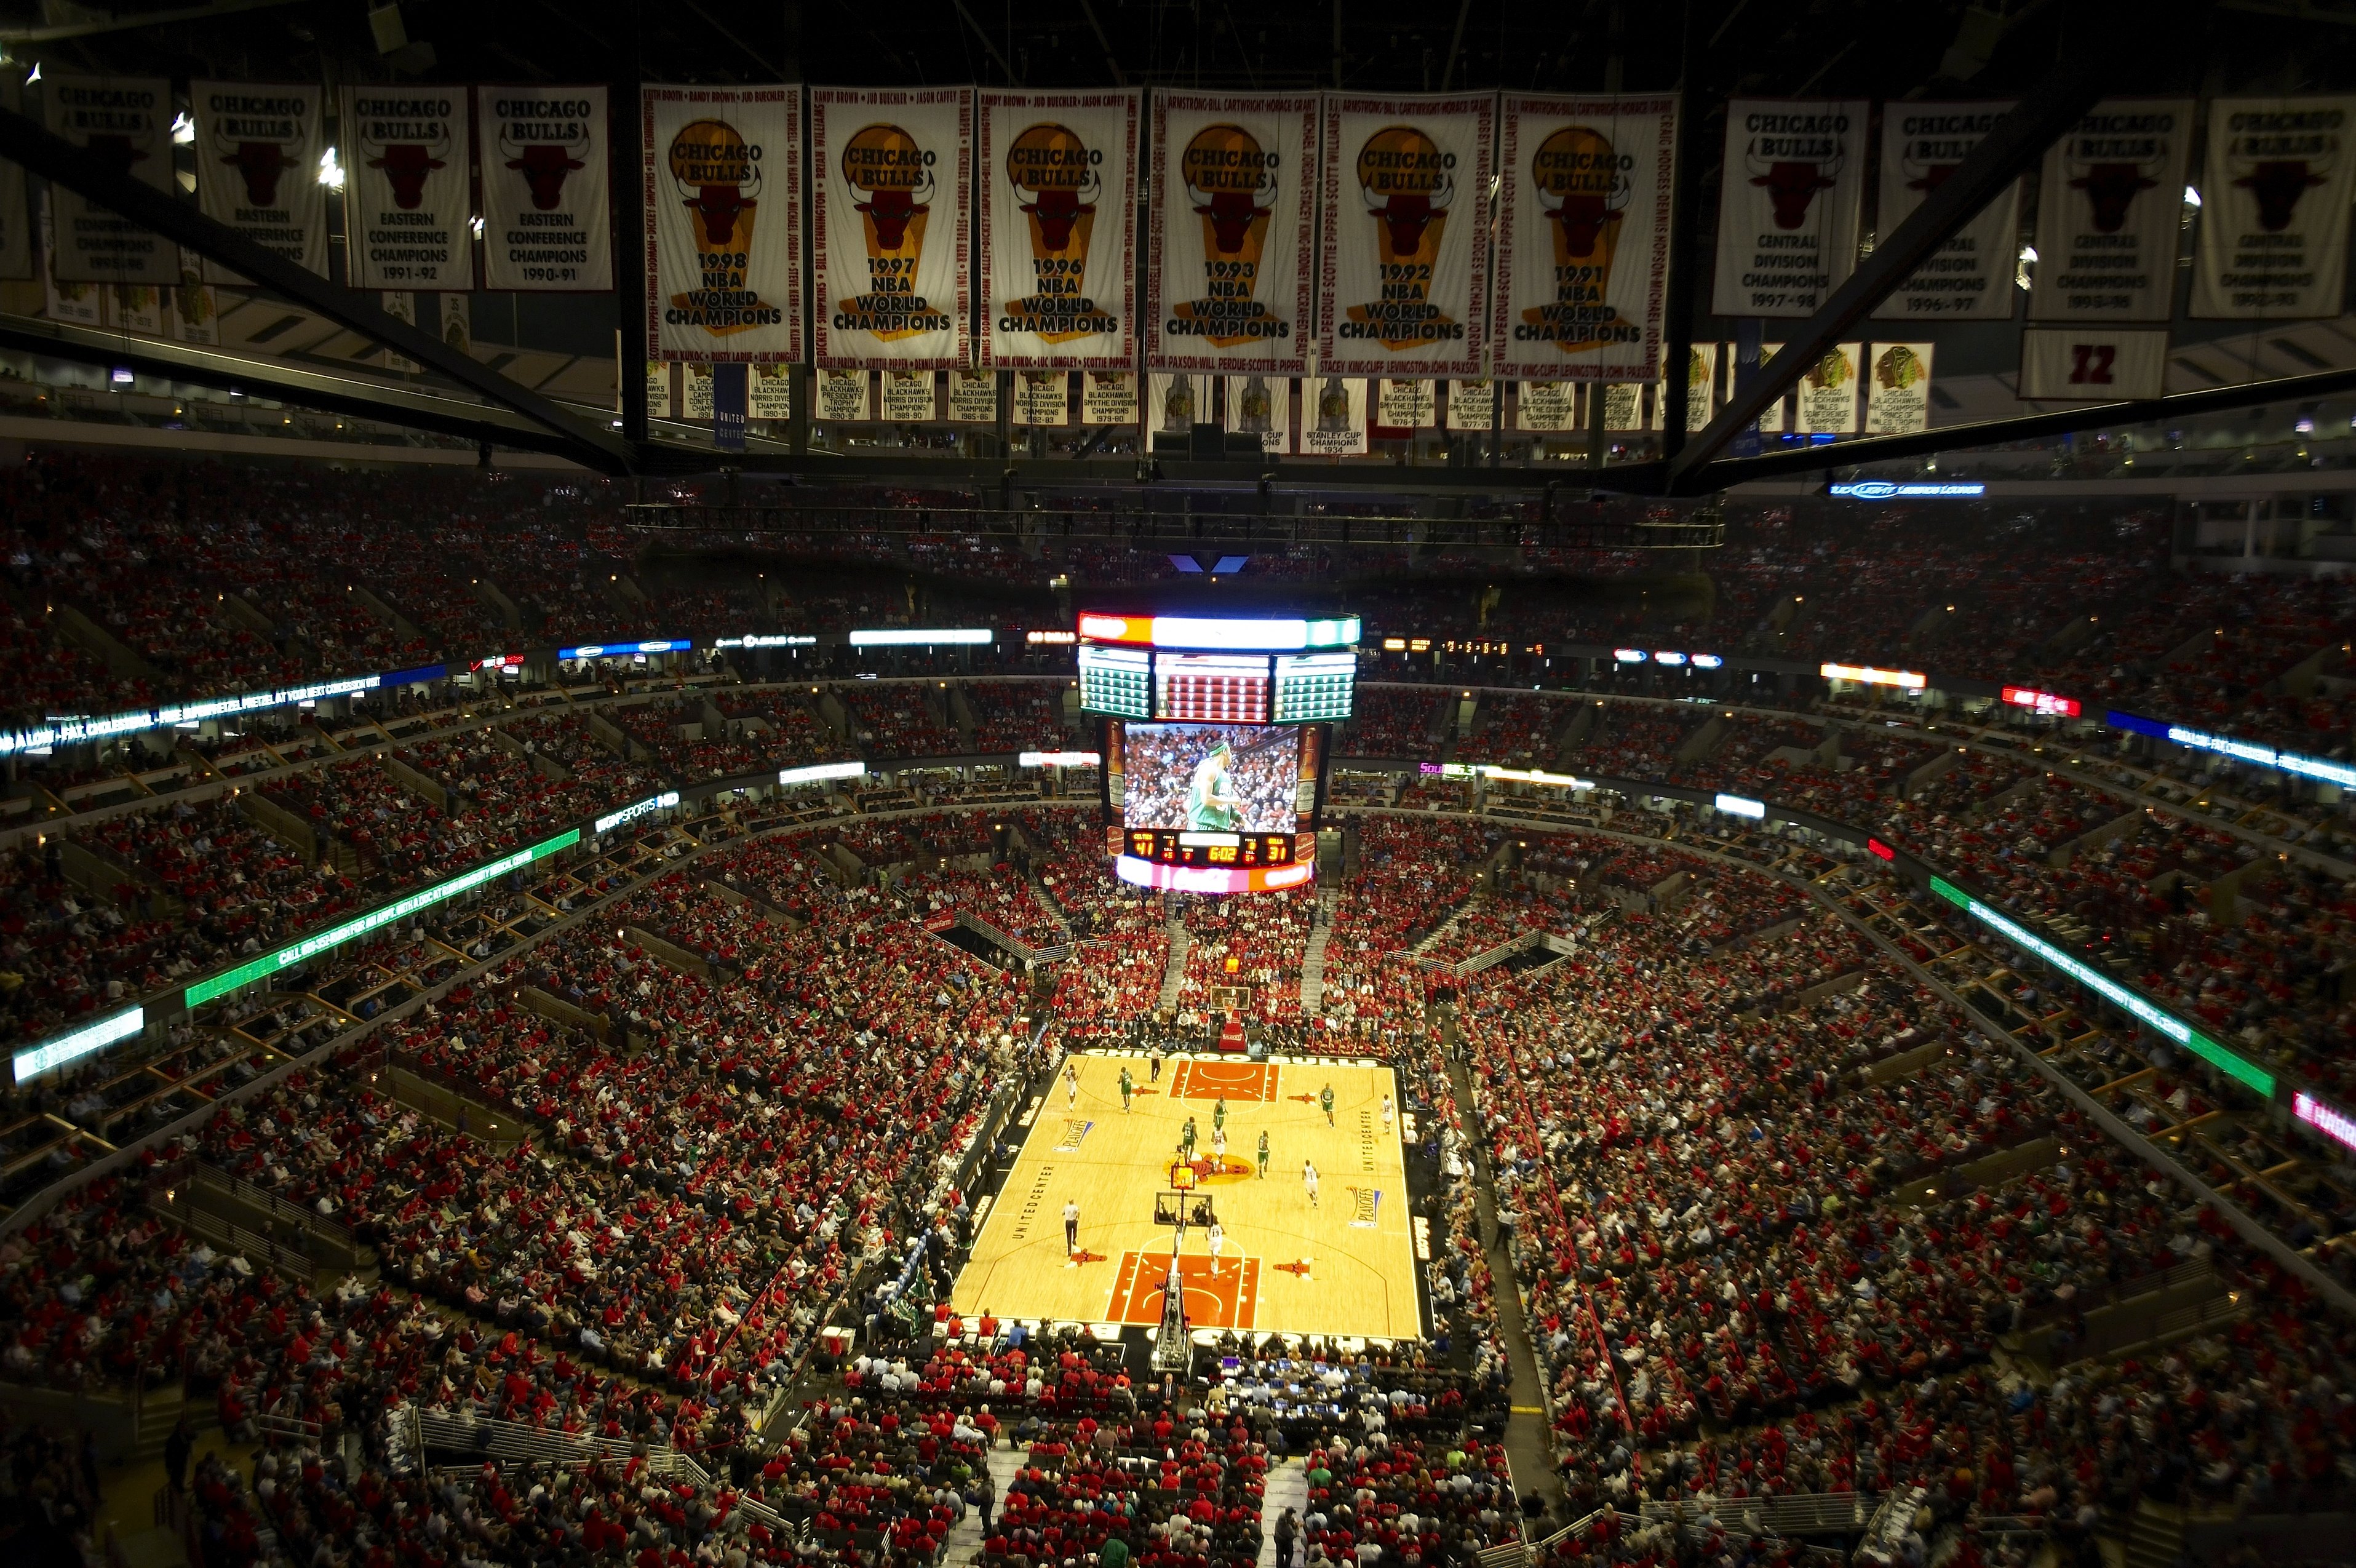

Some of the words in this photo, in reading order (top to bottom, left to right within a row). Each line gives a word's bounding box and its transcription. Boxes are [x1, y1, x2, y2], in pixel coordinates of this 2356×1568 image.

[211, 95, 304, 116] CHICAGO
[357, 100, 452, 117] CHICAGO
[496, 100, 591, 118] CHICAGO
[226, 119, 293, 137] BULLS
[373, 122, 439, 139] BULLS
[512, 123, 578, 140] BULLS
[1745, 114, 1849, 133] CHICAGO
[675, 143, 762, 161] CHICAGO
[1761, 138, 1833, 157] BULLS
[848, 148, 936, 165] CHICAGO
[1013, 149, 1102, 165] CHICAGO
[1188, 149, 1279, 168] CHICAGO
[1364, 150, 1456, 169] CHICAGO
[1539, 152, 1633, 170] CHICAGO
[689, 164, 750, 181] BULLS
[862, 170, 924, 186] BULLS
[1027, 168, 1089, 186] BULLS
[1202, 171, 1267, 189] BULLS
[1377, 173, 1443, 189] BULLS
[1552, 174, 1619, 191] BULLS
[381, 213, 434, 225] EASTERN
[520, 214, 573, 225] EASTERN
[369, 231, 448, 244] CONFERENCE
[507, 232, 586, 244] CONFERENCE
[1758, 234, 1817, 249] CENTRAL
[371, 249, 447, 262] CHAMPIONS
[509, 250, 586, 263] CHAMPIONS
[698, 252, 747, 269] 1998
[1754, 255, 1818, 269] DIVISION
[383, 267, 437, 279] 1991-92
[867, 258, 914, 273] 1997
[1033, 258, 1083, 275] 1996
[1204, 261, 1254, 277] 1993
[1380, 264, 1430, 280] 1992
[523, 268, 576, 281] 1990-91
[702, 272, 742, 289] NBA
[1555, 266, 1603, 282] 1991
[1742, 274, 1829, 288] CHAMPIONS
[872, 277, 911, 292] NBA
[1037, 277, 1078, 293] NBA
[1208, 281, 1249, 297] NBA
[1382, 284, 1424, 300] NBA
[688, 291, 758, 308] WORLD
[1558, 287, 1600, 301] NBA
[1752, 293, 1816, 307] 1997-98
[856, 296, 927, 312] WORLD
[1022, 296, 1094, 312] WORLD
[1191, 300, 1265, 317] WORLD
[1364, 303, 1439, 319] WORLD
[666, 309, 782, 325] CHAMPIONS
[834, 314, 950, 330] CHAMPIONS
[1540, 306, 1616, 322] WORLD
[998, 316, 1118, 332] CHAMPIONS
[1166, 319, 1290, 337] CHAMPIONS
[1339, 322, 1465, 340] CHAMPIONS
[1514, 325, 1641, 342] CHAMPIONS
[2069, 344, 2115, 384] 72
[1137, 842, 1153, 855] 41
[1209, 847, 1236, 860] 6:02
[1268, 847, 1286, 859] 31
[1268, 1056, 1378, 1068] BULLS
[1063, 1120, 1087, 1148] PLAYOFFS
[1358, 1188, 1373, 1222] PLAYOFFS
